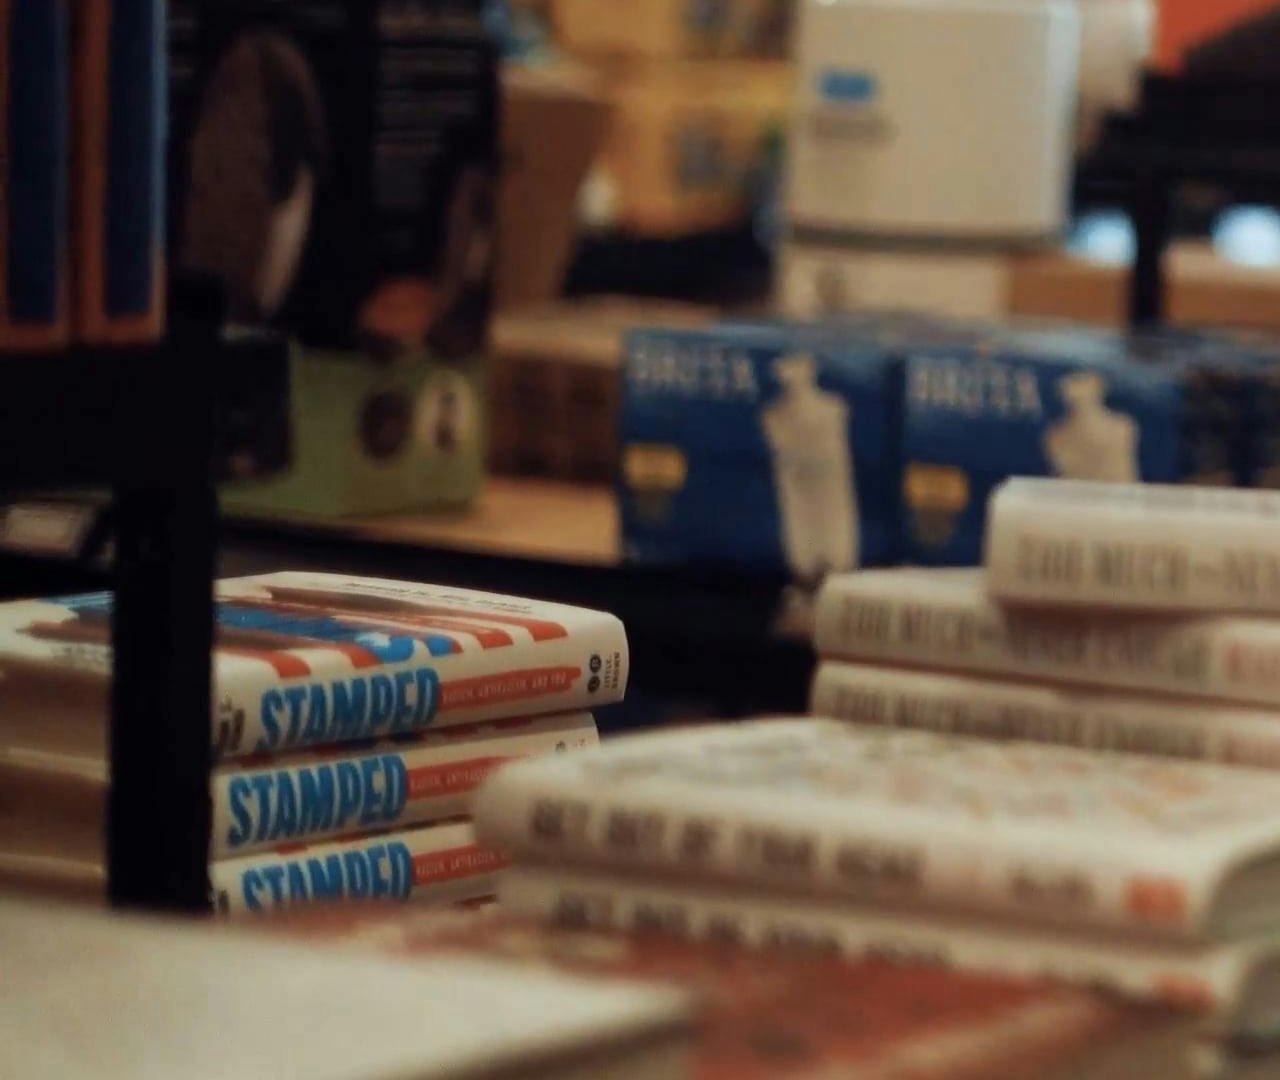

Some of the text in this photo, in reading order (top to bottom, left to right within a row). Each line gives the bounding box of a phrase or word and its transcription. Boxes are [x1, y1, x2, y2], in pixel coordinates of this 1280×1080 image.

[258, 667, 440, 751] STAMPED
[226, 754, 408, 848] STAMPED
[241, 841, 413, 913] STAMPED
